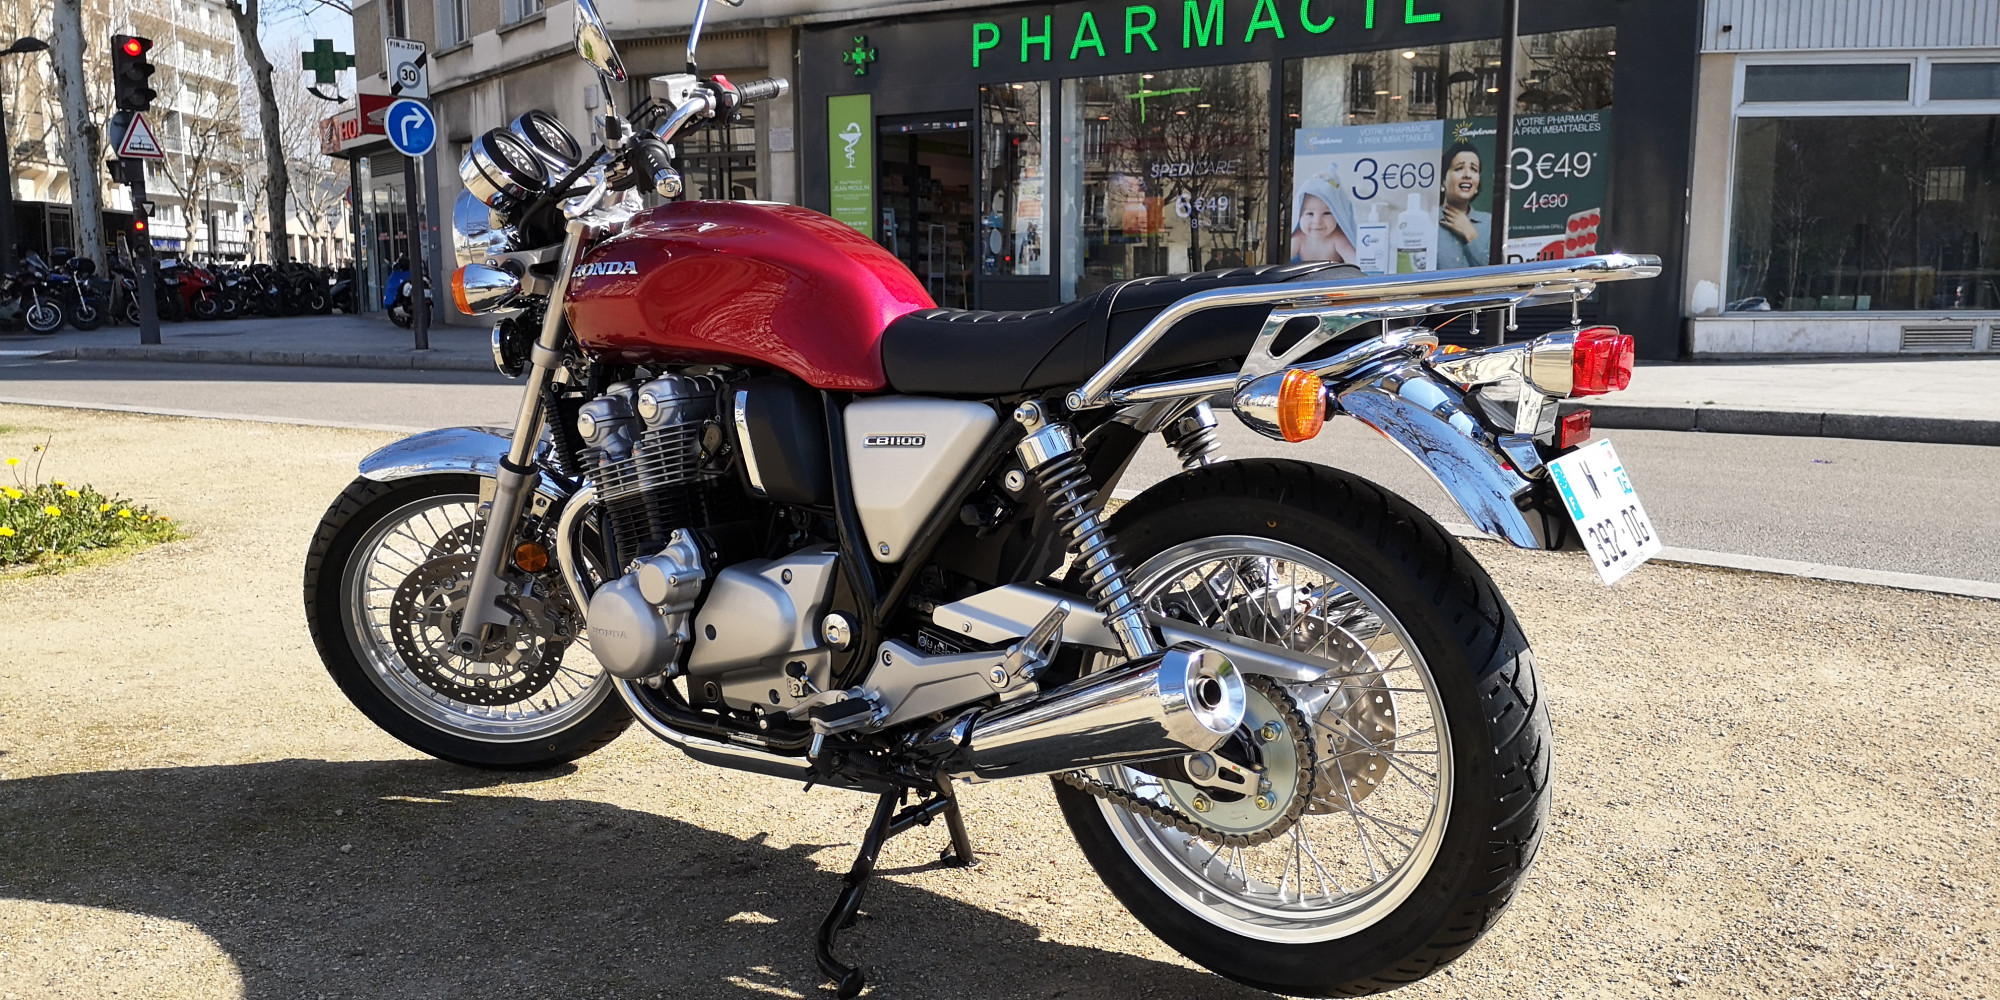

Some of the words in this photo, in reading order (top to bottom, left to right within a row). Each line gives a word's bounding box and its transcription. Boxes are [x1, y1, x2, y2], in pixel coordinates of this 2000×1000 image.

[406, 43, 424, 51] ZONE
[401, 69, 417, 82] 30
[1516, 117, 1546, 127] VOTRE
[1547, 113, 1599, 125] PHARMACIE
[1360, 127, 1385, 136] VOTRE
[1386, 124, 1432, 134] PHARMACIE
[1521, 126, 1541, 136] PRIX
[1542, 122, 1601, 134] IMBATTABLES
[1383, 132, 1434, 143] IMBATTABLES
[1150, 160, 1237, 178] SPEDICARE
[1352, 157, 1435, 201] 3€69
[1175, 193, 1229, 218] 6€49
[1522, 191, 1569, 213] 4€90
[571, 260, 638, 278] HONDA
[864, 436, 924, 446] CB1100
[591, 626, 627, 640] HONDA
